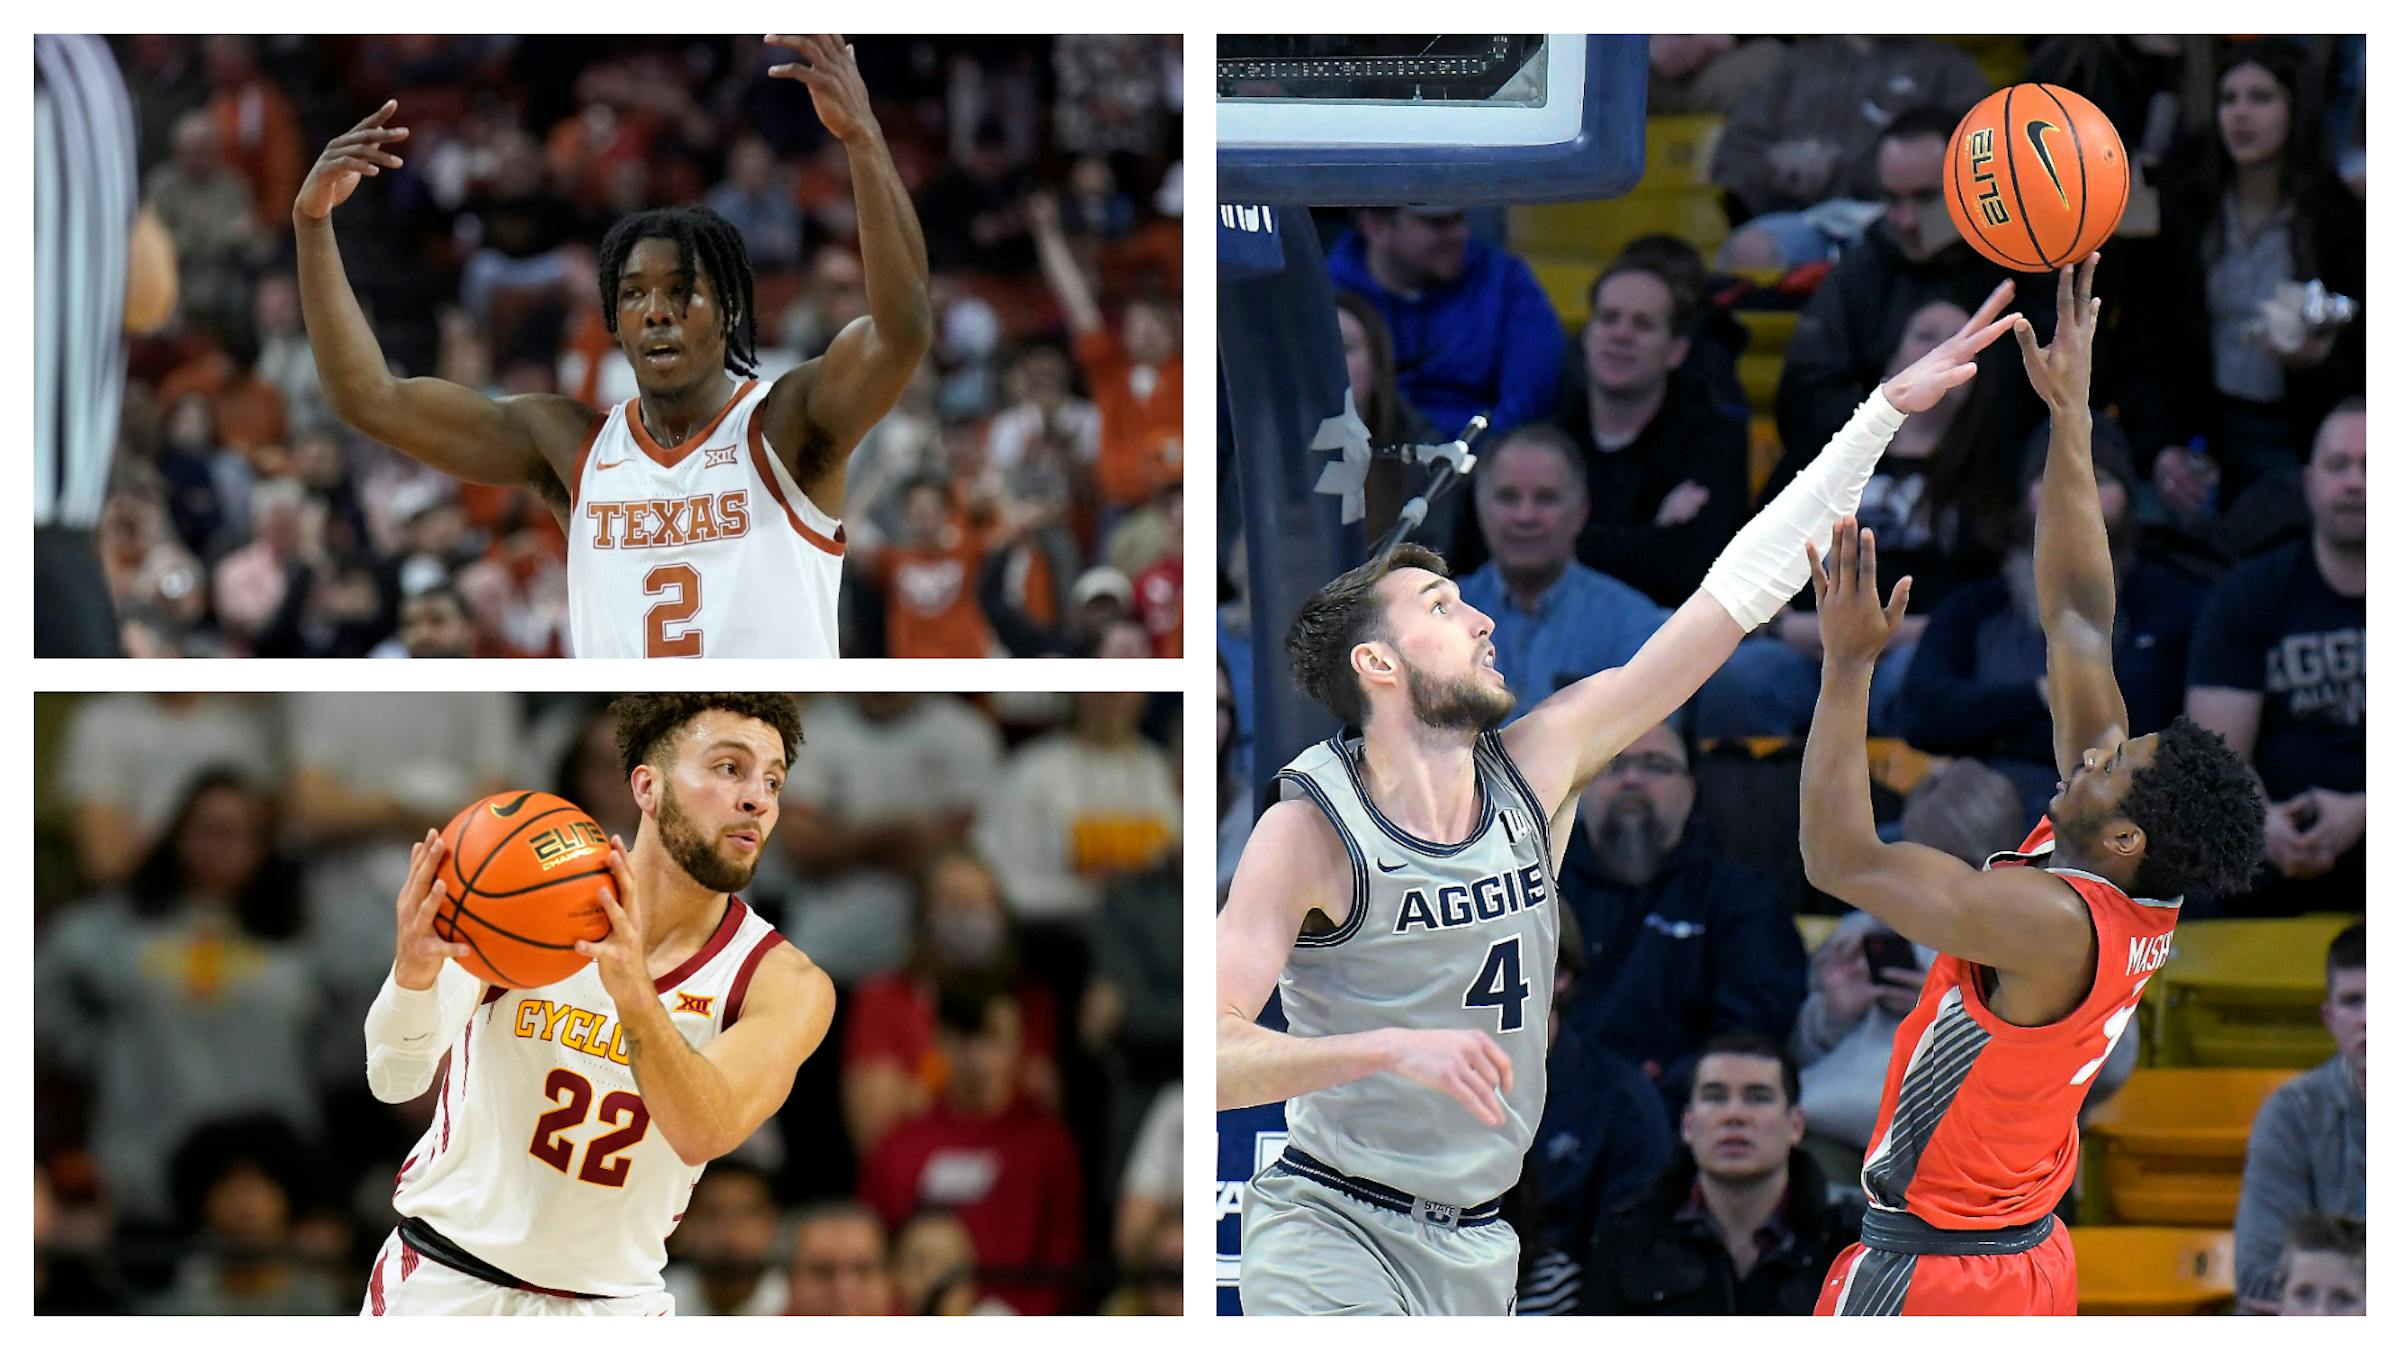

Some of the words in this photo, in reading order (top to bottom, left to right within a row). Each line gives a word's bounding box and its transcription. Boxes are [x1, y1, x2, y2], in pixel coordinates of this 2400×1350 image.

[1971, 128, 2011, 227] ELITE
[587, 489, 750, 549] TEXAS
[643, 562, 703, 659] 2
[529, 821, 606, 863] ELITE
[1461, 933, 1531, 1034] 4
[2125, 929, 2175, 976] MASH
[529, 1067, 651, 1187] 22
